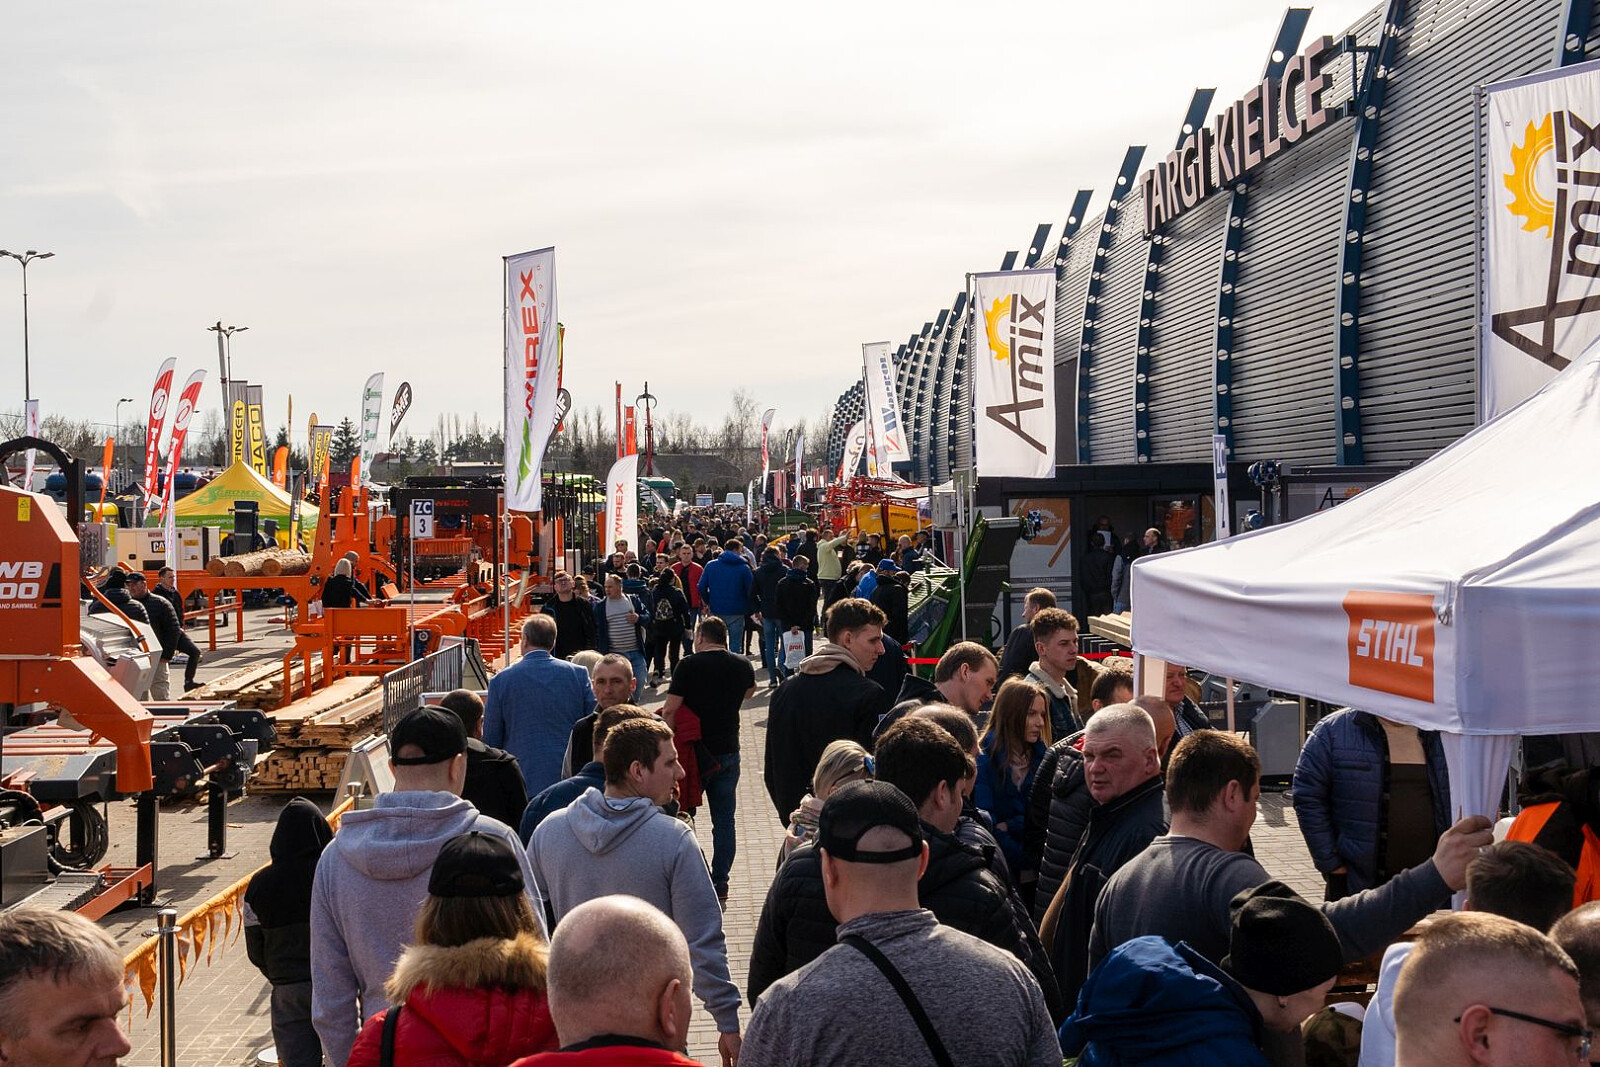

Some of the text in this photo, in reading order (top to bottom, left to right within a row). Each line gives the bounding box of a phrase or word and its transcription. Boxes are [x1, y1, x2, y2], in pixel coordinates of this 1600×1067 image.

[1139, 36, 1330, 235] TARGI KIELCE
[519, 268, 540, 420] WIREX
[986, 293, 1047, 455] Amix
[392, 386, 409, 425] BMF
[552, 392, 567, 425] MF
[234, 406, 244, 462] FINGER
[250, 406, 265, 476] RACO
[415, 501, 432, 514] ZC
[419, 518, 426, 533] 3
[615, 482, 625, 536] WIREX
[1220, 487, 1226, 529] 2
[0, 583, 40, 600] 00
[1356, 618, 1424, 668] STIHL
